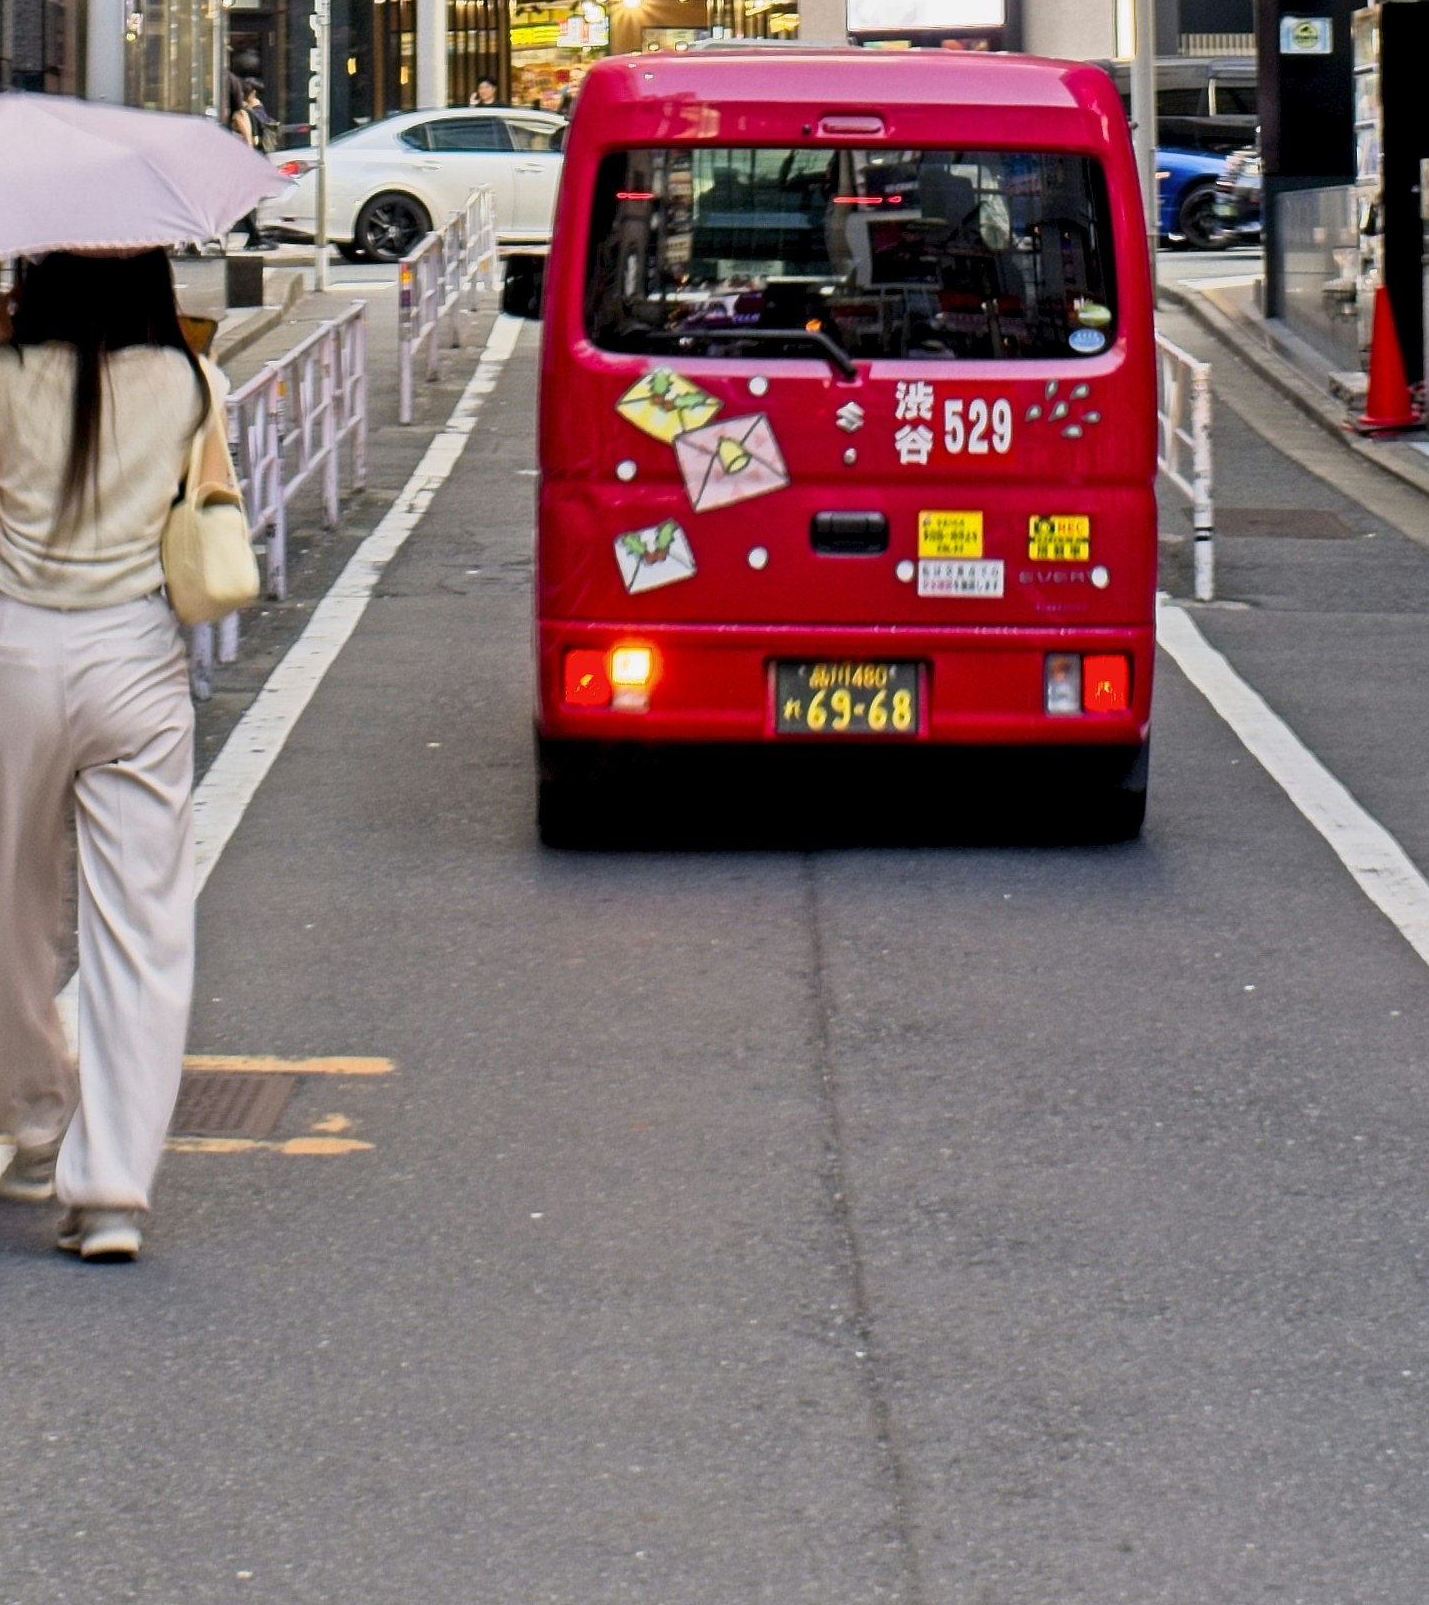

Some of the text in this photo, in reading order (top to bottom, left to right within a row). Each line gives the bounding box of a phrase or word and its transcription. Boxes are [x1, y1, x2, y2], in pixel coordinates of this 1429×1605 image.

[894, 380, 1014, 468] 渋谷 529
[1018, 570, 1092, 585] EVER
[806, 688, 912, 732] 69-68
